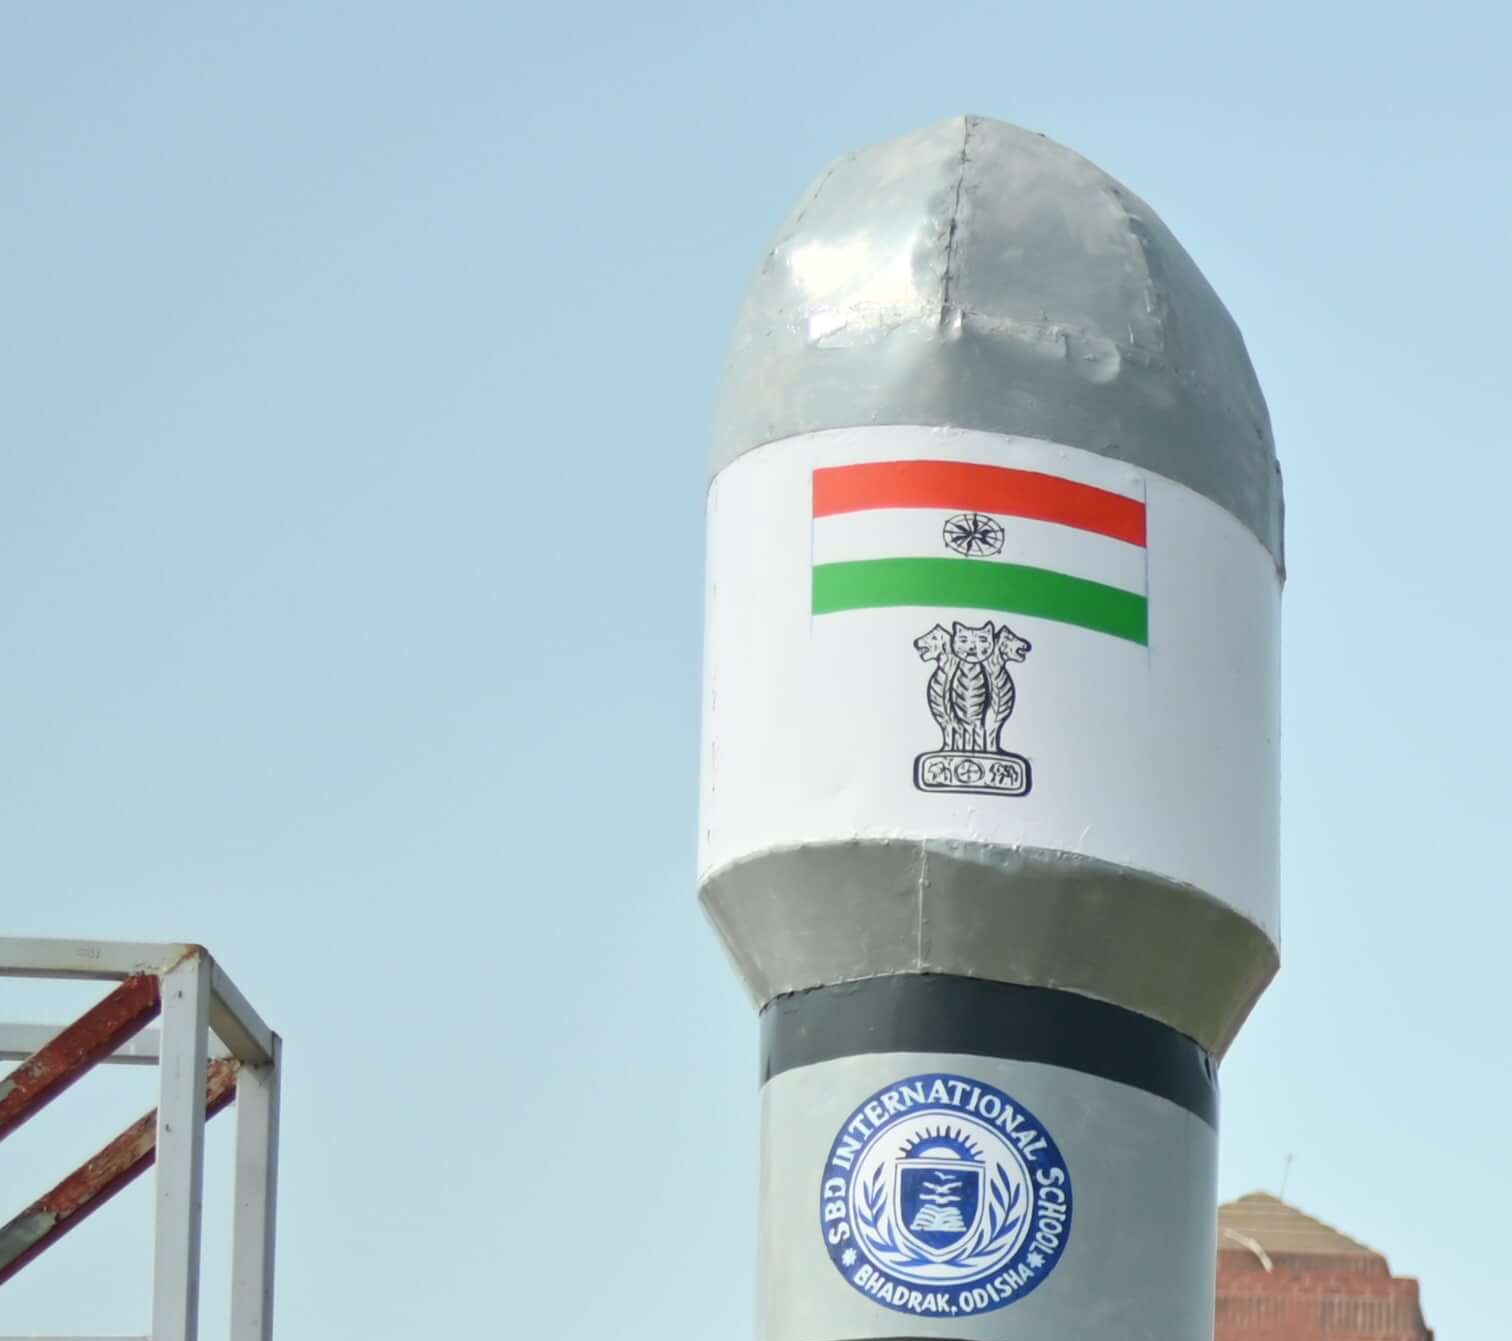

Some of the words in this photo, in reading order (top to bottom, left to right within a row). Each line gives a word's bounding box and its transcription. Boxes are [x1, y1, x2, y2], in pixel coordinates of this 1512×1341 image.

[832, 1079, 1047, 1171] INTERNATIONAL
[824, 1177, 849, 1244] SBD
[1033, 1167, 1066, 1254] SCHOOL
[854, 1265, 957, 1315] BHADRAK,
[959, 1264, 1033, 1311] ODISHA
